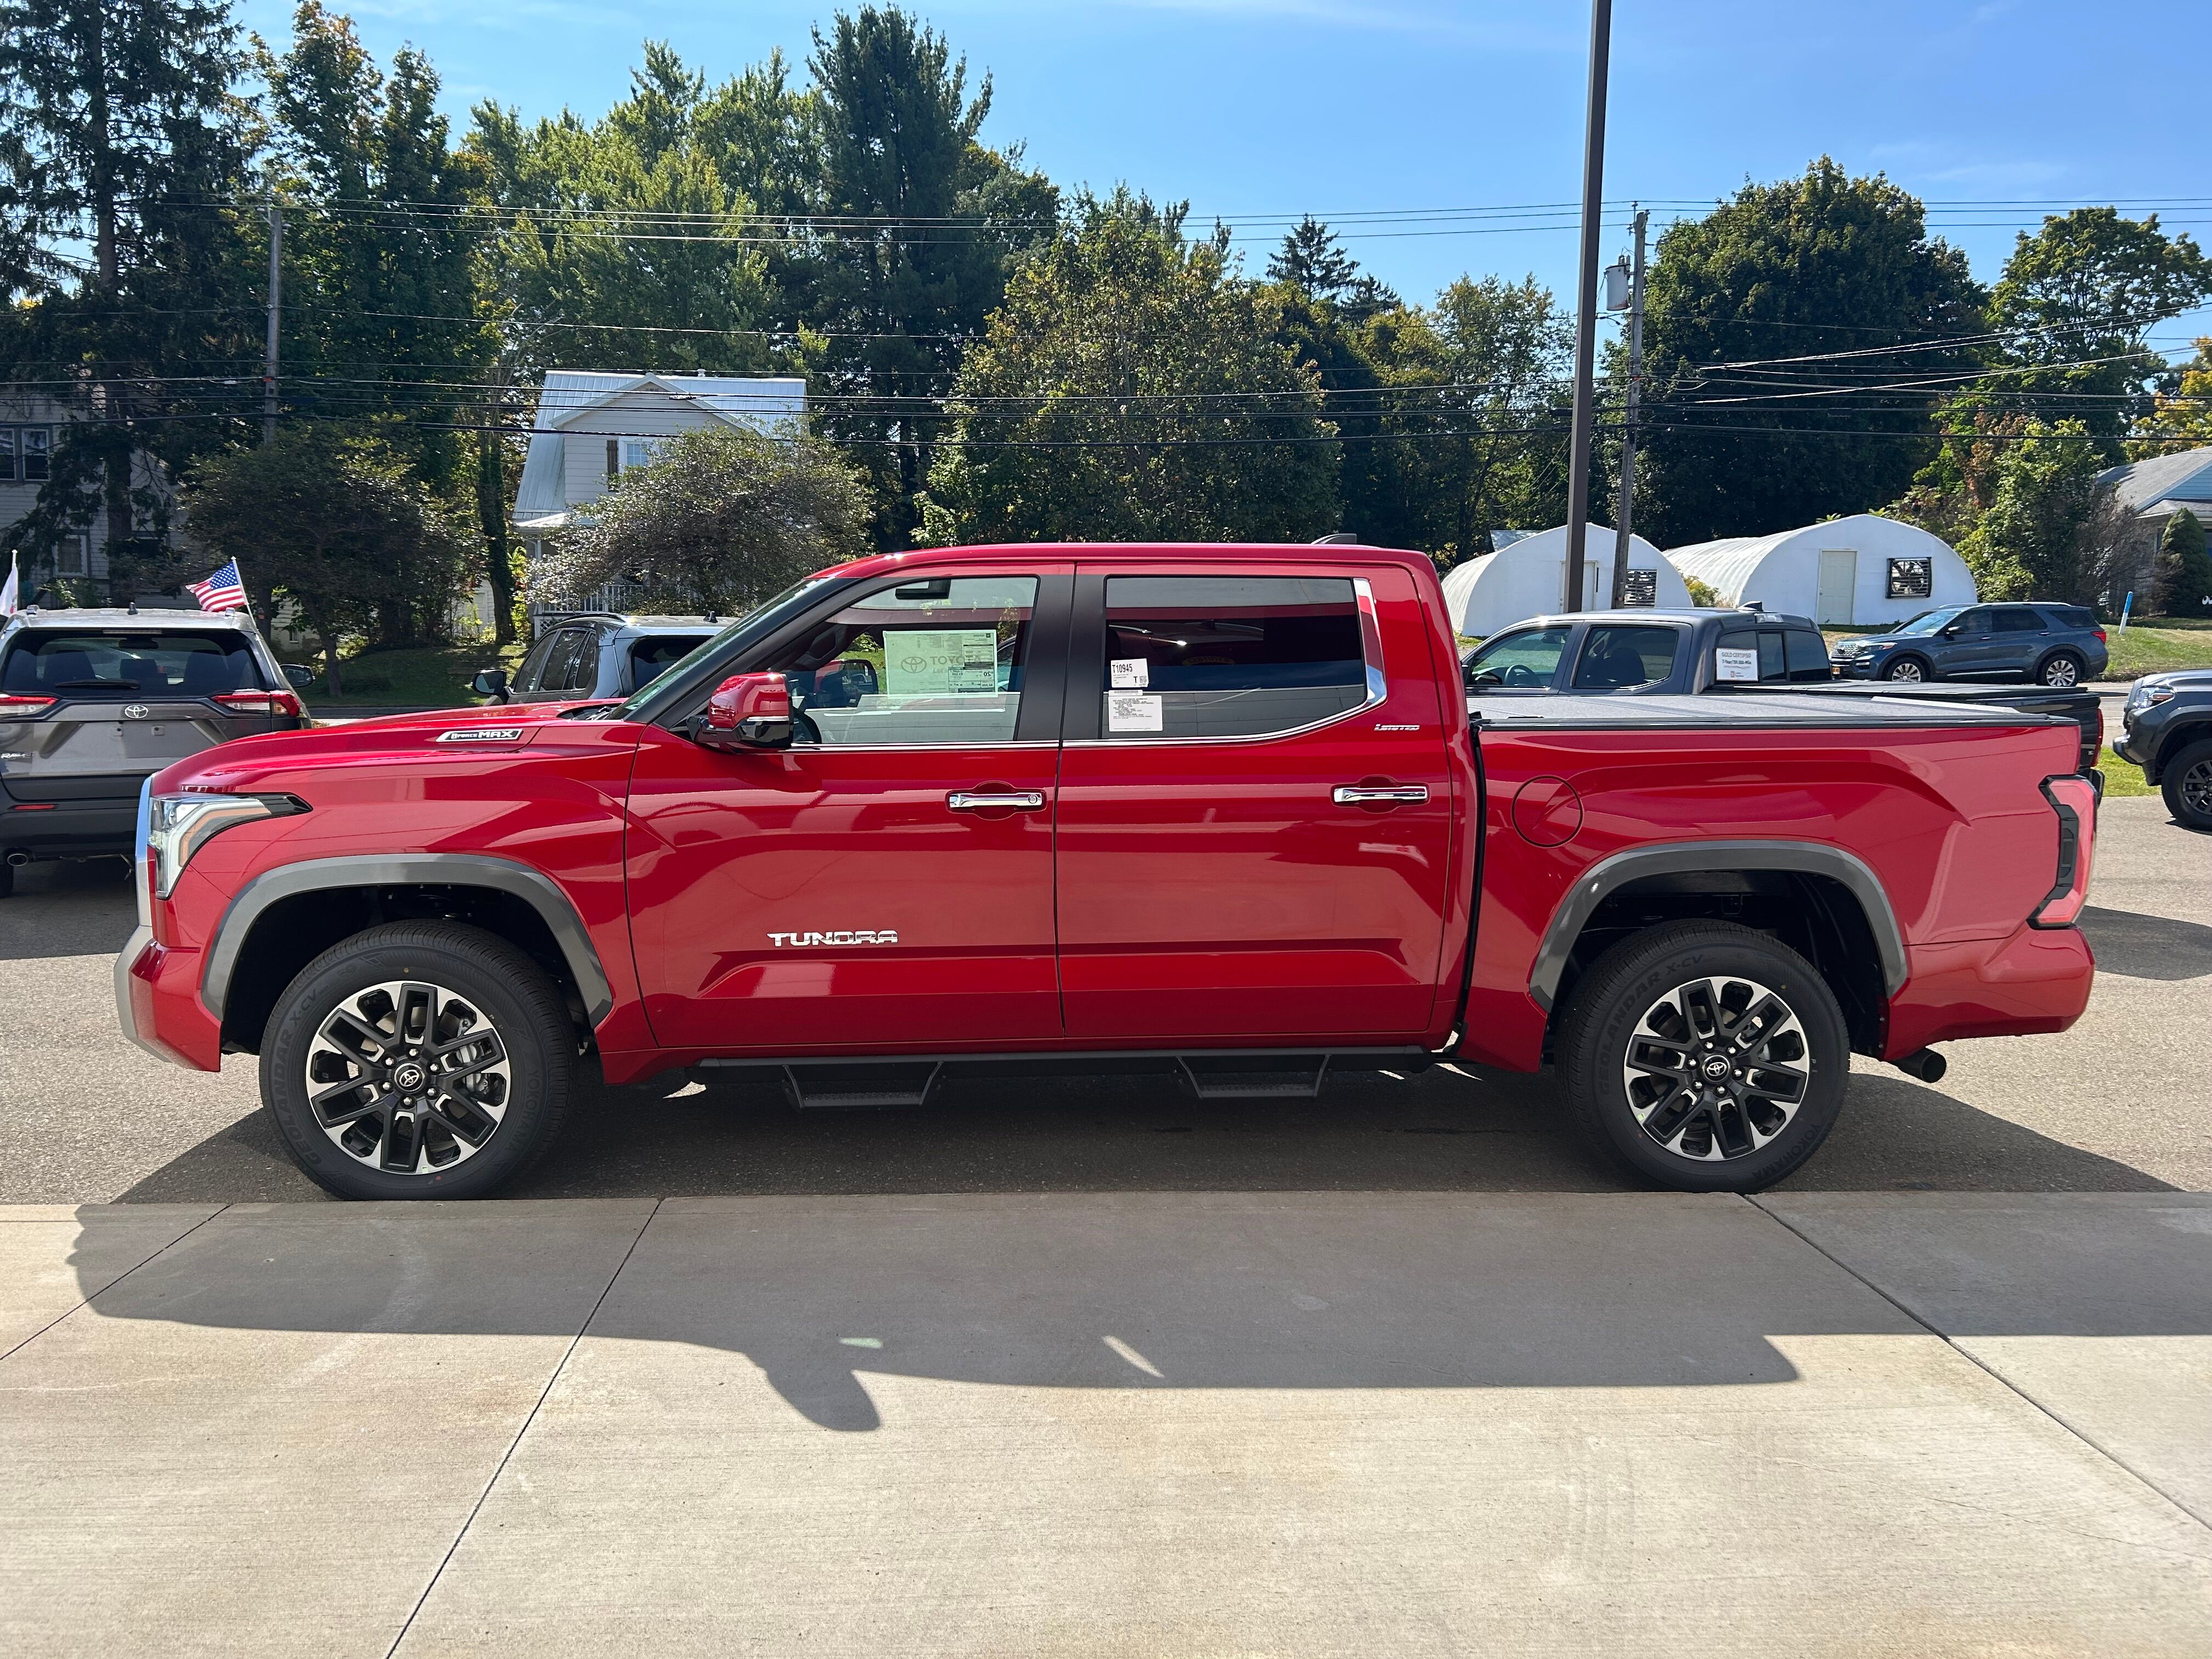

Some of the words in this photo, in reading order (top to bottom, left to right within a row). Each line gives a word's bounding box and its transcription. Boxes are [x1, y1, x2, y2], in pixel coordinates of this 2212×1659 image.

[929, 656, 964, 665] TOYO
[1112, 664, 1133, 673] T10945
[766, 930, 898, 947] TUNDRA
[289, 989, 317, 1028] X-CV
[275, 1028, 321, 1164] GEOLANDAR
